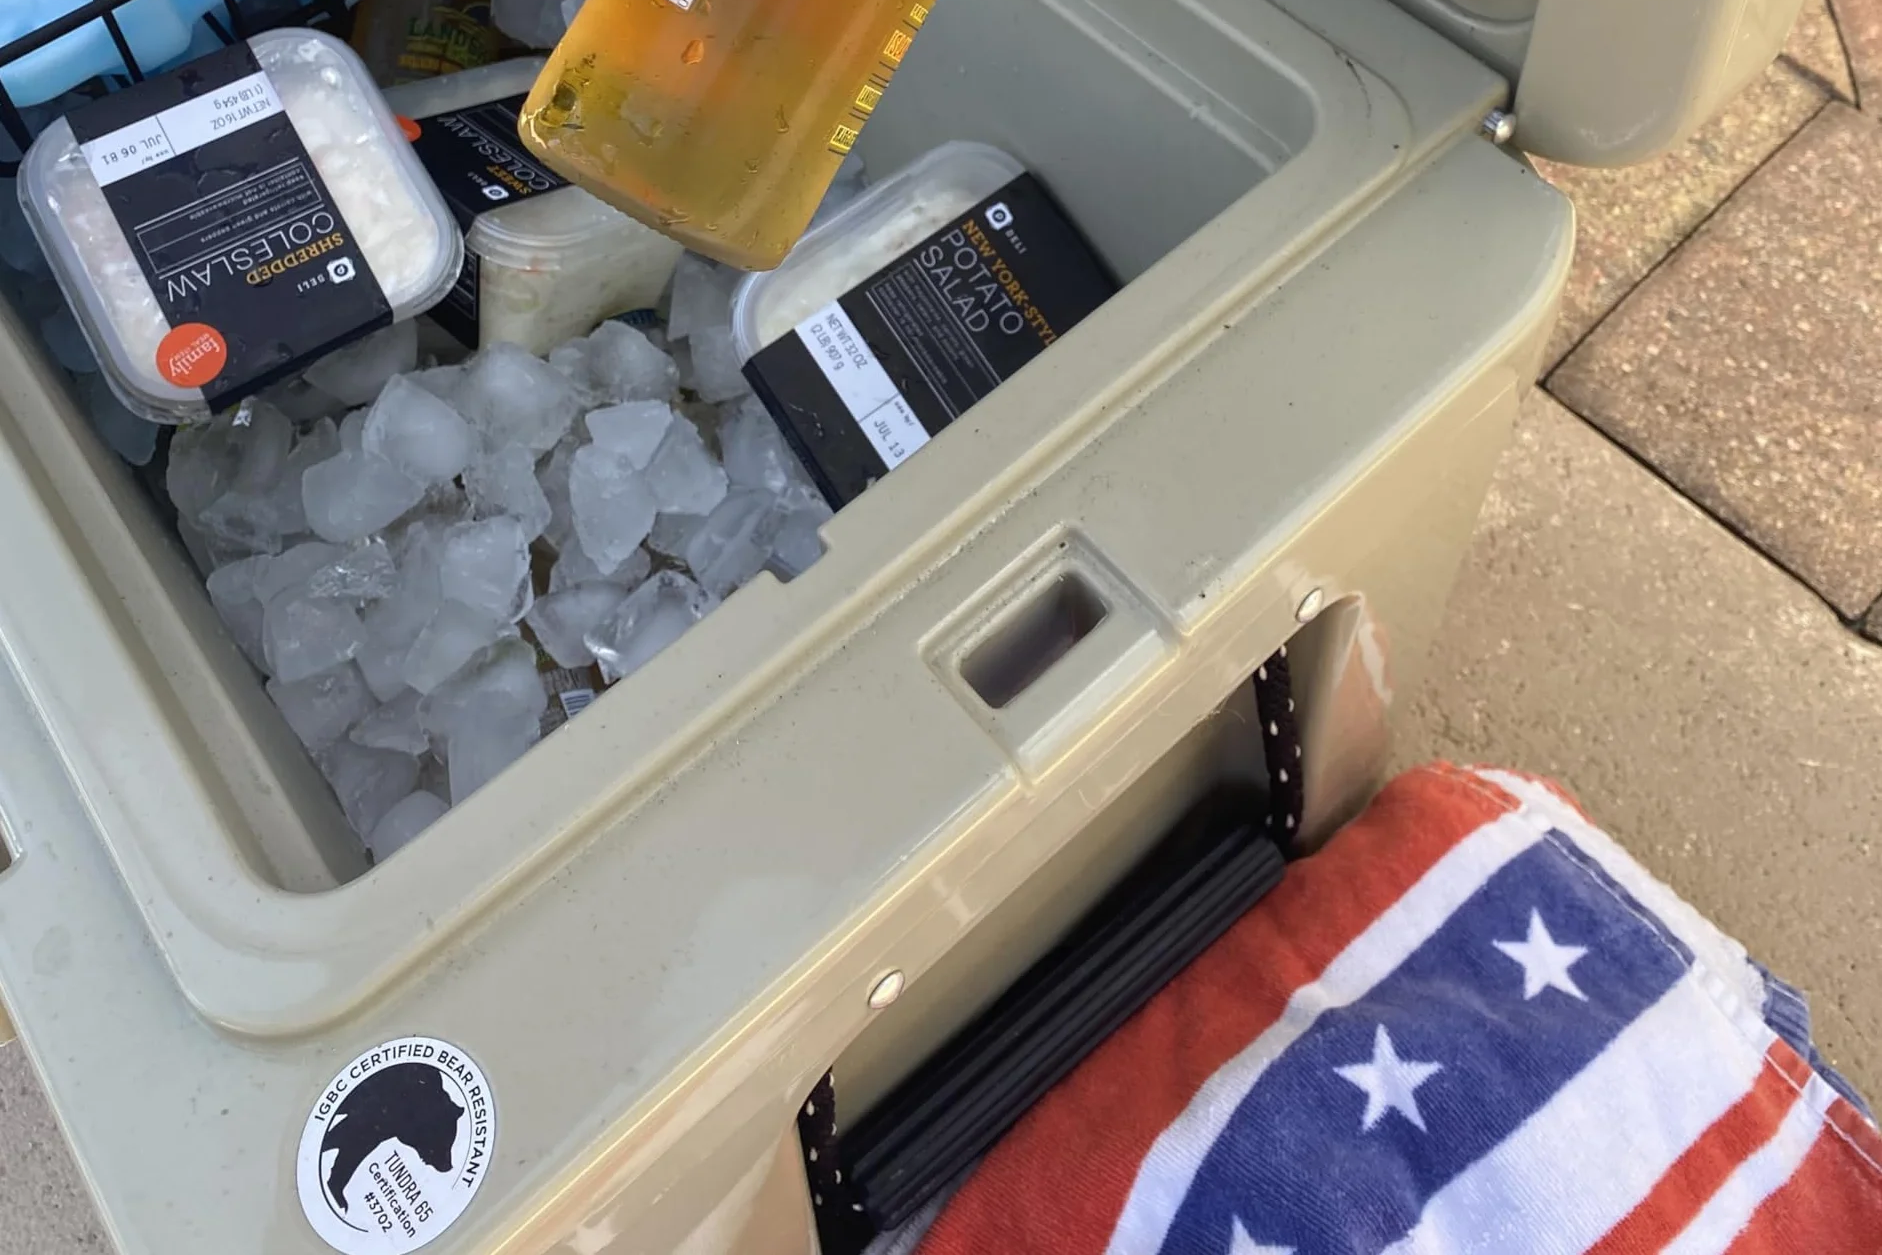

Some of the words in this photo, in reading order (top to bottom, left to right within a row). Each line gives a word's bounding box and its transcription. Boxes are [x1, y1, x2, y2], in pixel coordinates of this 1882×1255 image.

[222, 96, 238, 108] 454
[238, 106, 253, 119] WT
[252, 97, 271, 113] NET
[210, 117, 225, 130] OZ
[225, 113, 237, 124] 16
[121, 145, 136, 158] 06
[139, 134, 161, 149] JUL
[438, 117, 550, 190] COLESLAW
[486, 165, 532, 194] SWEET
[168, 212, 334, 302] COLESLAW
[247, 232, 344, 284] SHREDDED
[920, 245, 989, 332] SALAD
[940, 229, 1023, 334] POTATO
[962, 220, 995, 256] NEW
[991, 258, 1058, 347] YORK-STYL
[827, 313, 844, 330] NET
[837, 328, 852, 344] WT
[169, 337, 221, 378] family
[825, 345, 842, 360] 907
[845, 343, 860, 359] 32
[852, 353, 869, 371] OZ
[874, 421, 891, 441] JUL
[888, 442, 905, 458] 13
[314, 1079, 347, 1121] IGBC
[350, 1044, 434, 1079] CERTIFIED
[437, 1050, 473, 1086] BEAR
[462, 1086, 487, 1188] RESISTANT
[368, 1162, 416, 1238] Certification
[384, 1150, 422, 1206] TUNDRA
[413, 1200, 434, 1223] 65
[364, 1191, 393, 1233] #3702
